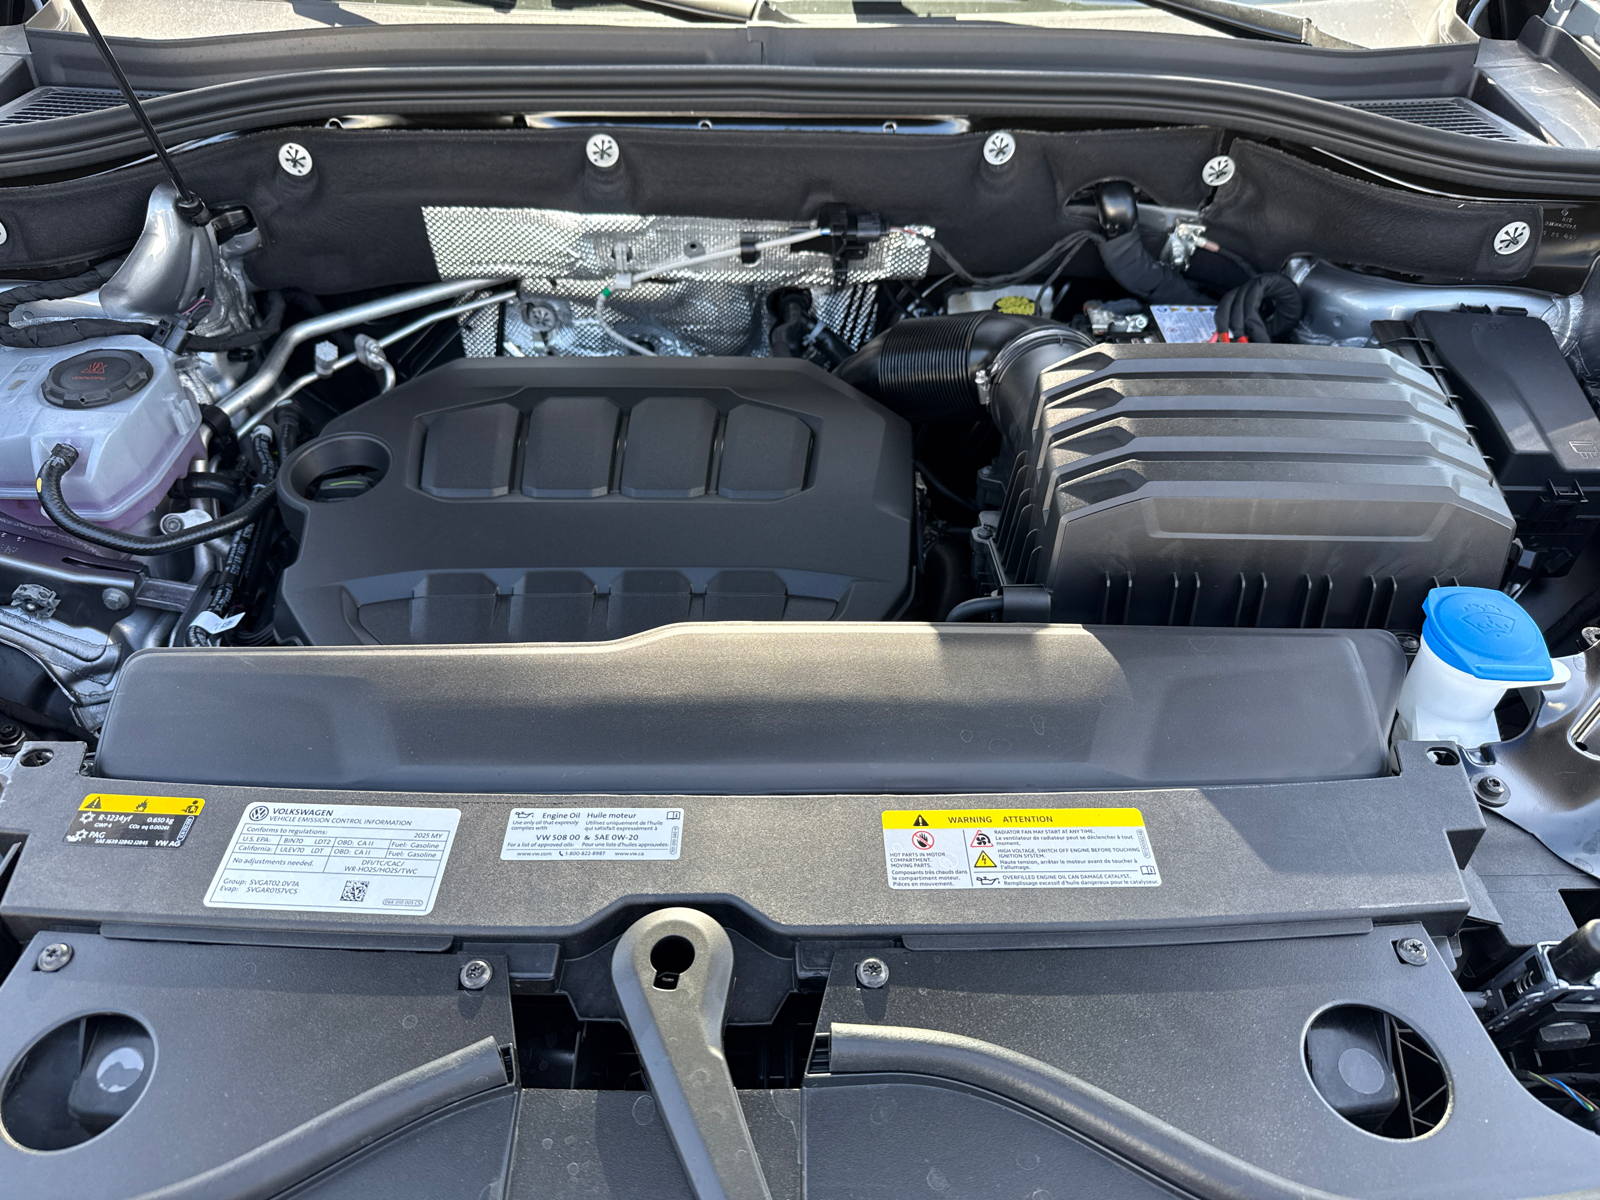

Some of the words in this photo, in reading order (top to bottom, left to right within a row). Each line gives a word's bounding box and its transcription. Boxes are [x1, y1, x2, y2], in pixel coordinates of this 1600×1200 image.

[272, 808, 334, 816] VOLKSWAGEN
[98, 814, 133, 824] R-1234yf
[344, 866, 418, 874] WR-HO2S/HO2S/TWC
